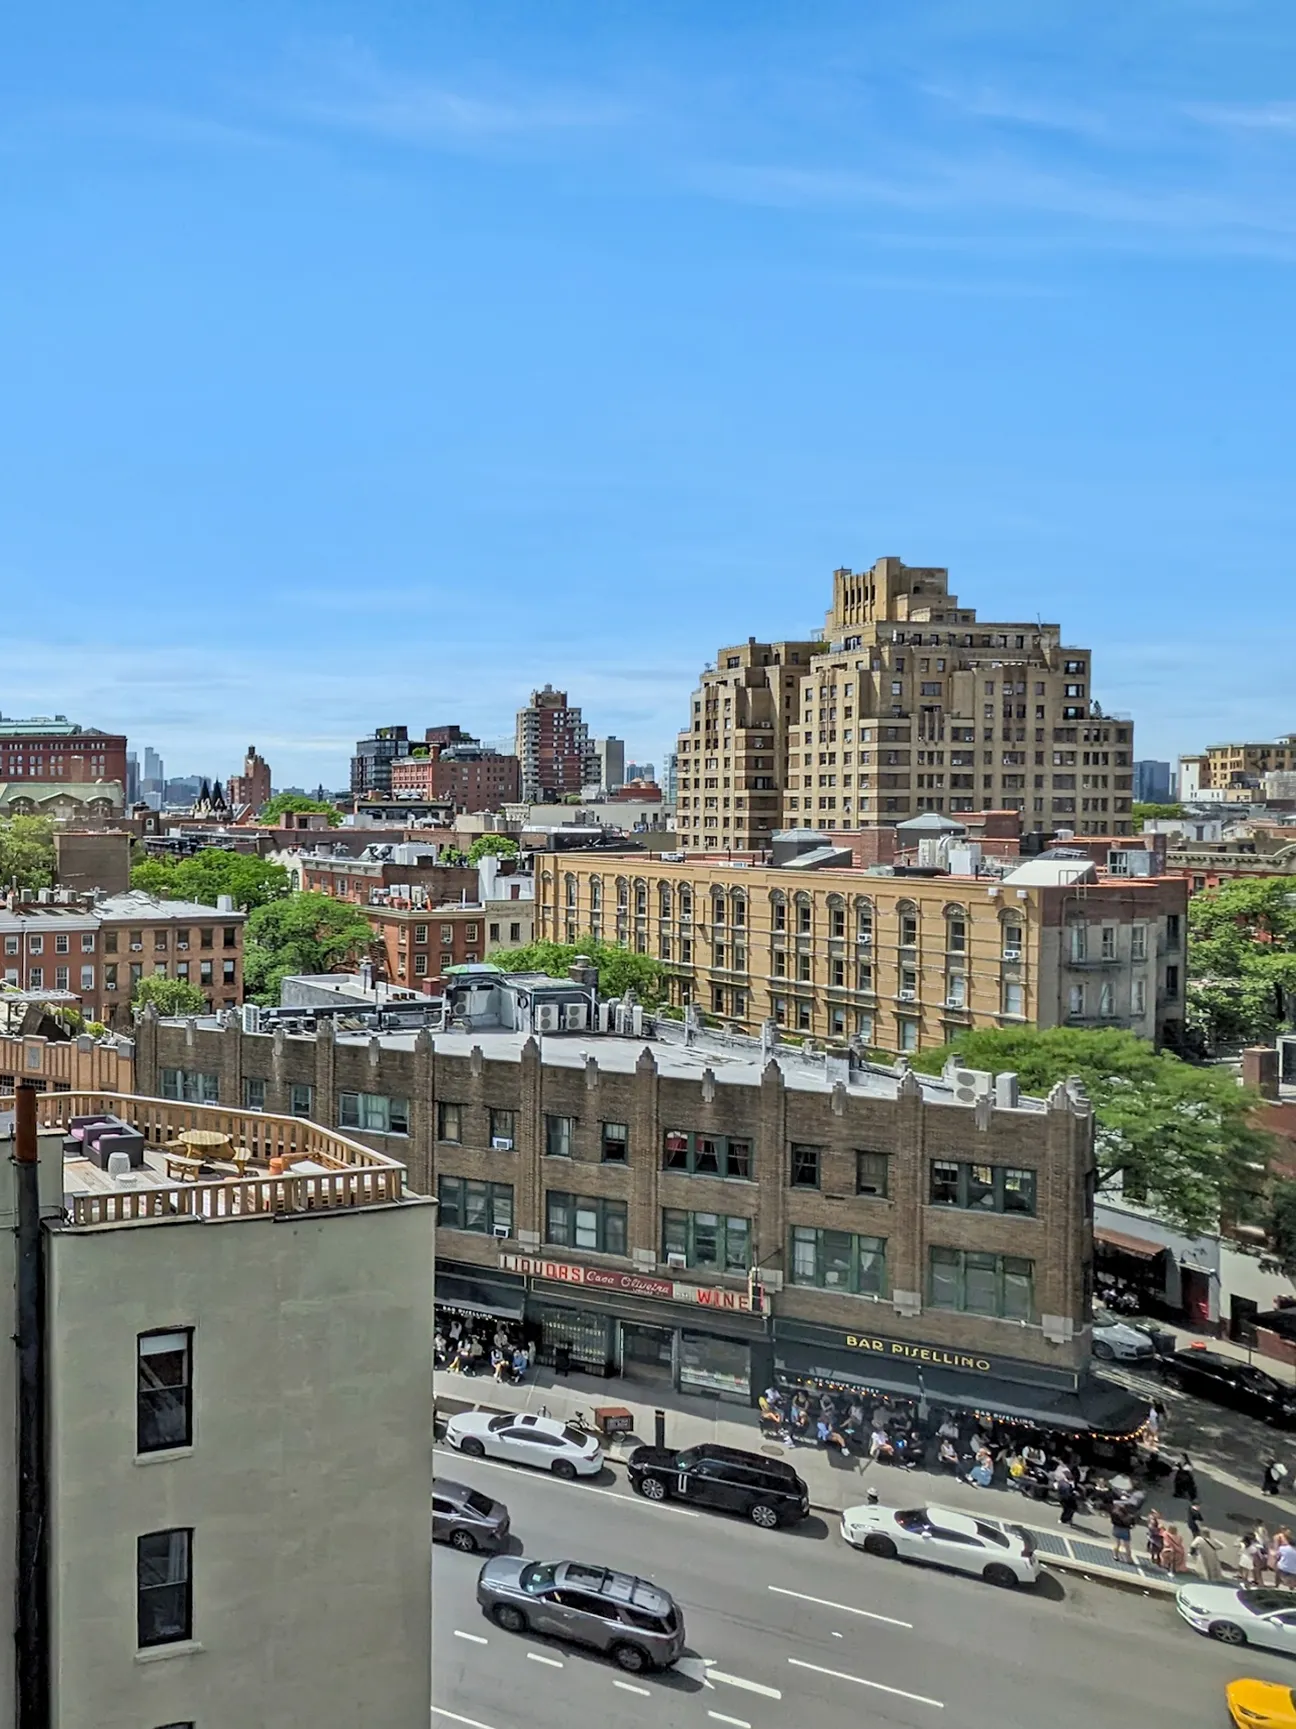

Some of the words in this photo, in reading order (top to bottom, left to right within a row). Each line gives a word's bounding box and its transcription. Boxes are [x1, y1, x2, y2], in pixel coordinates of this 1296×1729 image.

[504, 1256, 580, 1281] LIQUORS
[586, 1270, 615, 1284] Casa
[620, 1276, 669, 1294] Oliveira
[846, 1335, 884, 1352] BAR
[891, 1344, 990, 1370] PISELLINO
